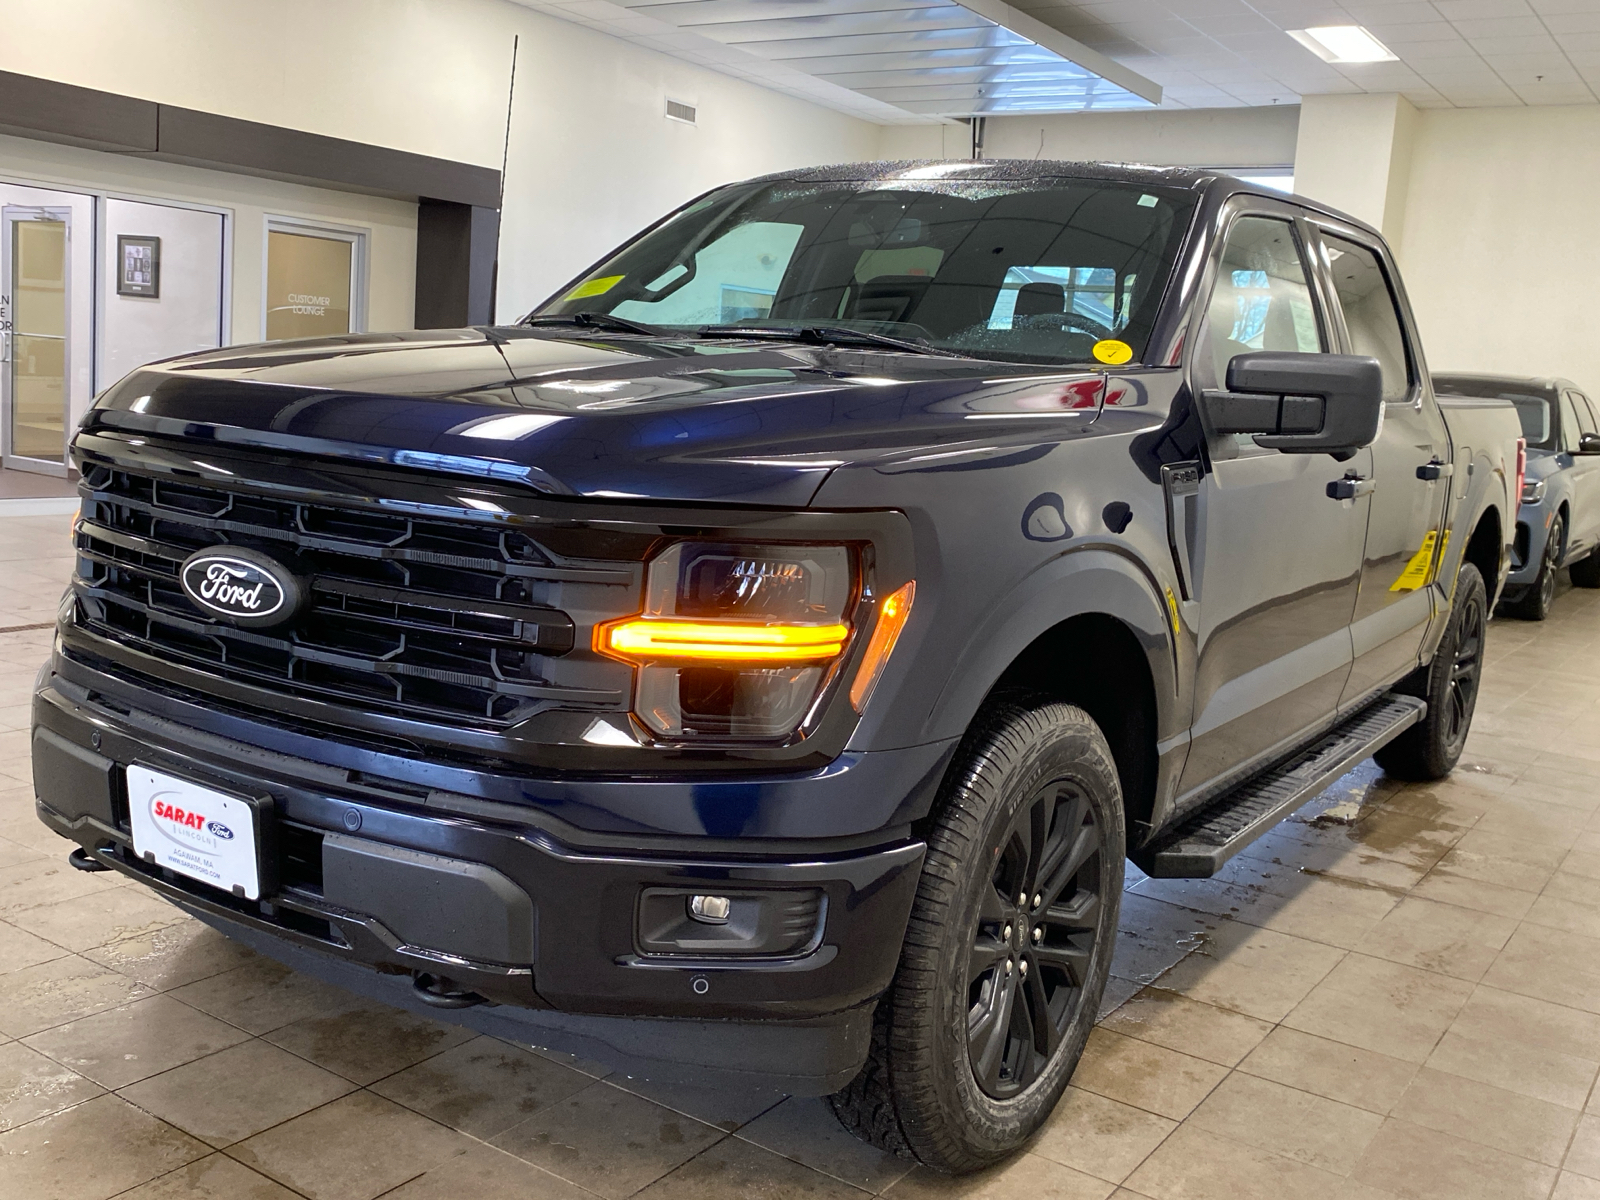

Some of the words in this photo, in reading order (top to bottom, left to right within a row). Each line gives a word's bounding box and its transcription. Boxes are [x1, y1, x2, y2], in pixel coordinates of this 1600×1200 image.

[288, 293, 330, 306] CUSTOMER
[292, 305, 325, 316] LOUNGE
[200, 563, 263, 609] Ford
[155, 801, 205, 830] SARAT
[178, 828, 211, 844] LINCOLN
[211, 823, 230, 839] Ford
[203, 858, 214, 869] MA
